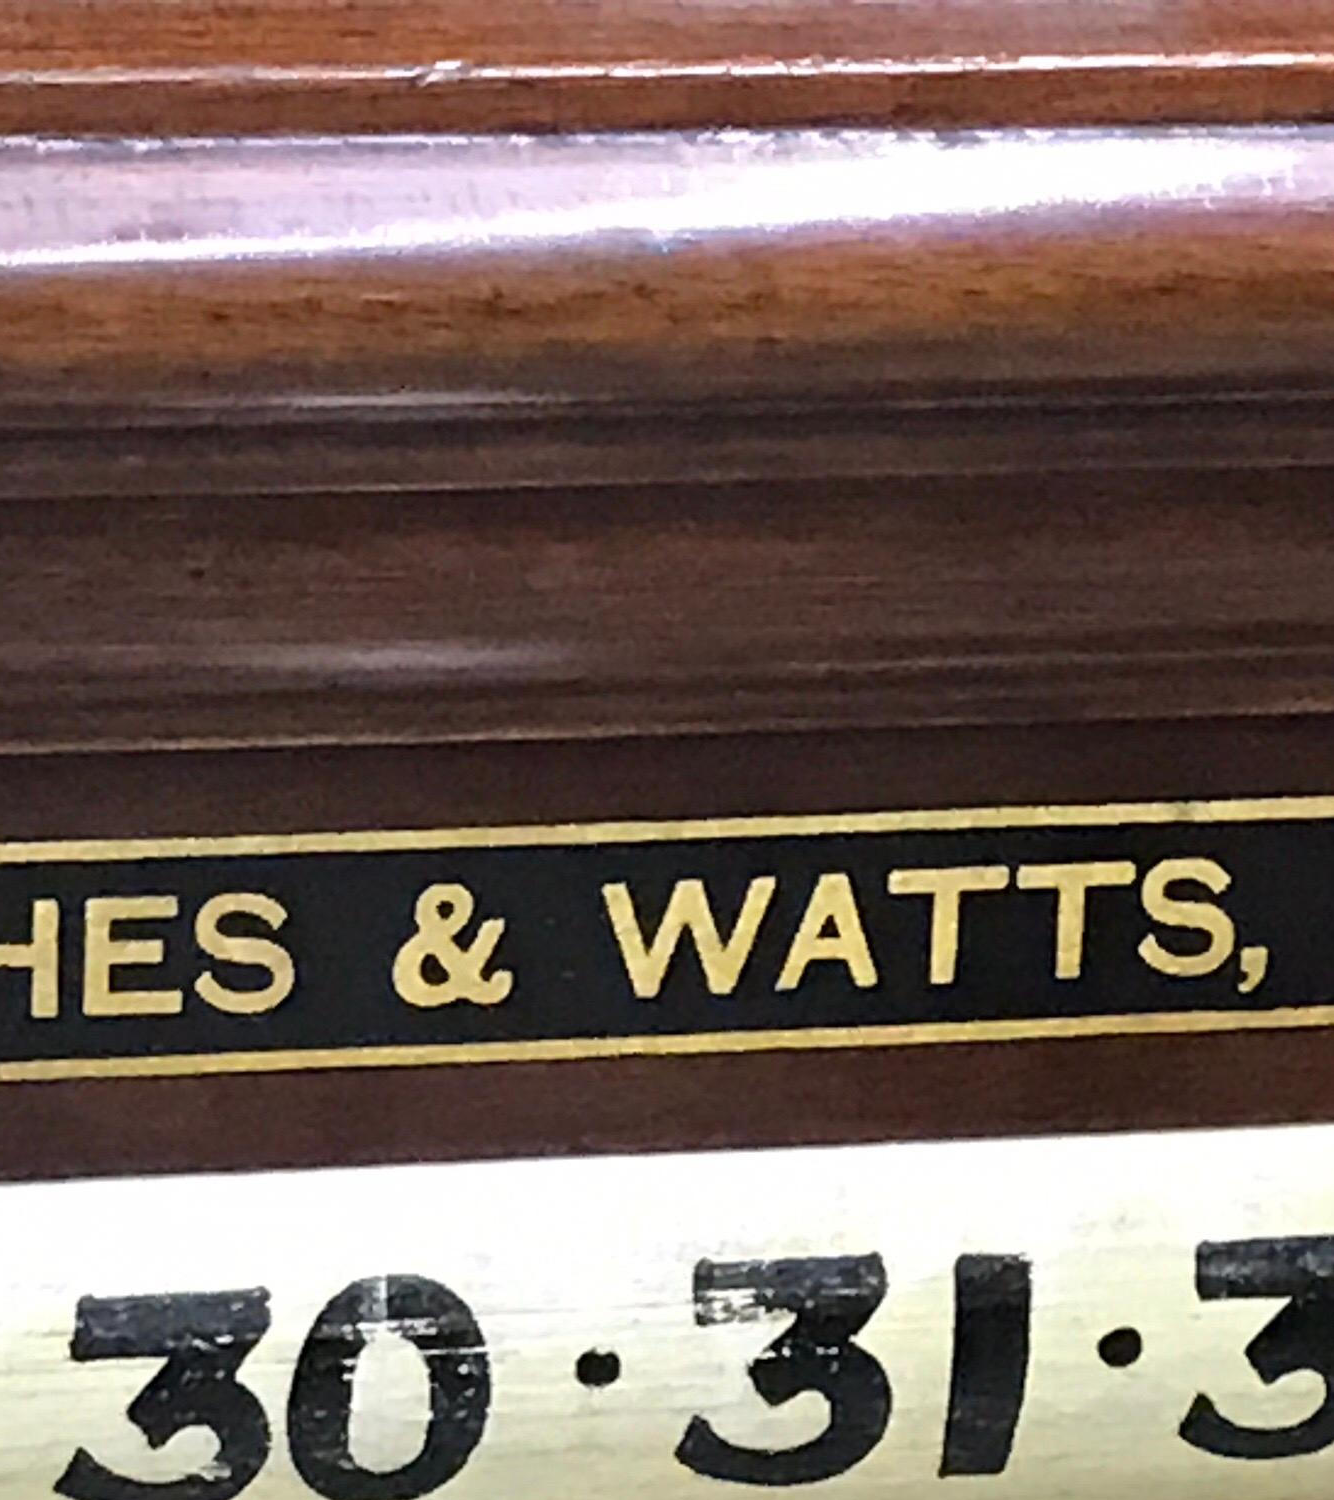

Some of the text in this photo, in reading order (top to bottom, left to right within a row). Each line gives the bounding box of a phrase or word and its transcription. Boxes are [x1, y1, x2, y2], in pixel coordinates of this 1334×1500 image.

[392, 884, 513, 1007] &
[602, 856, 1269, 998] WATTS,
[673, 1252, 1032, 1487] 31
